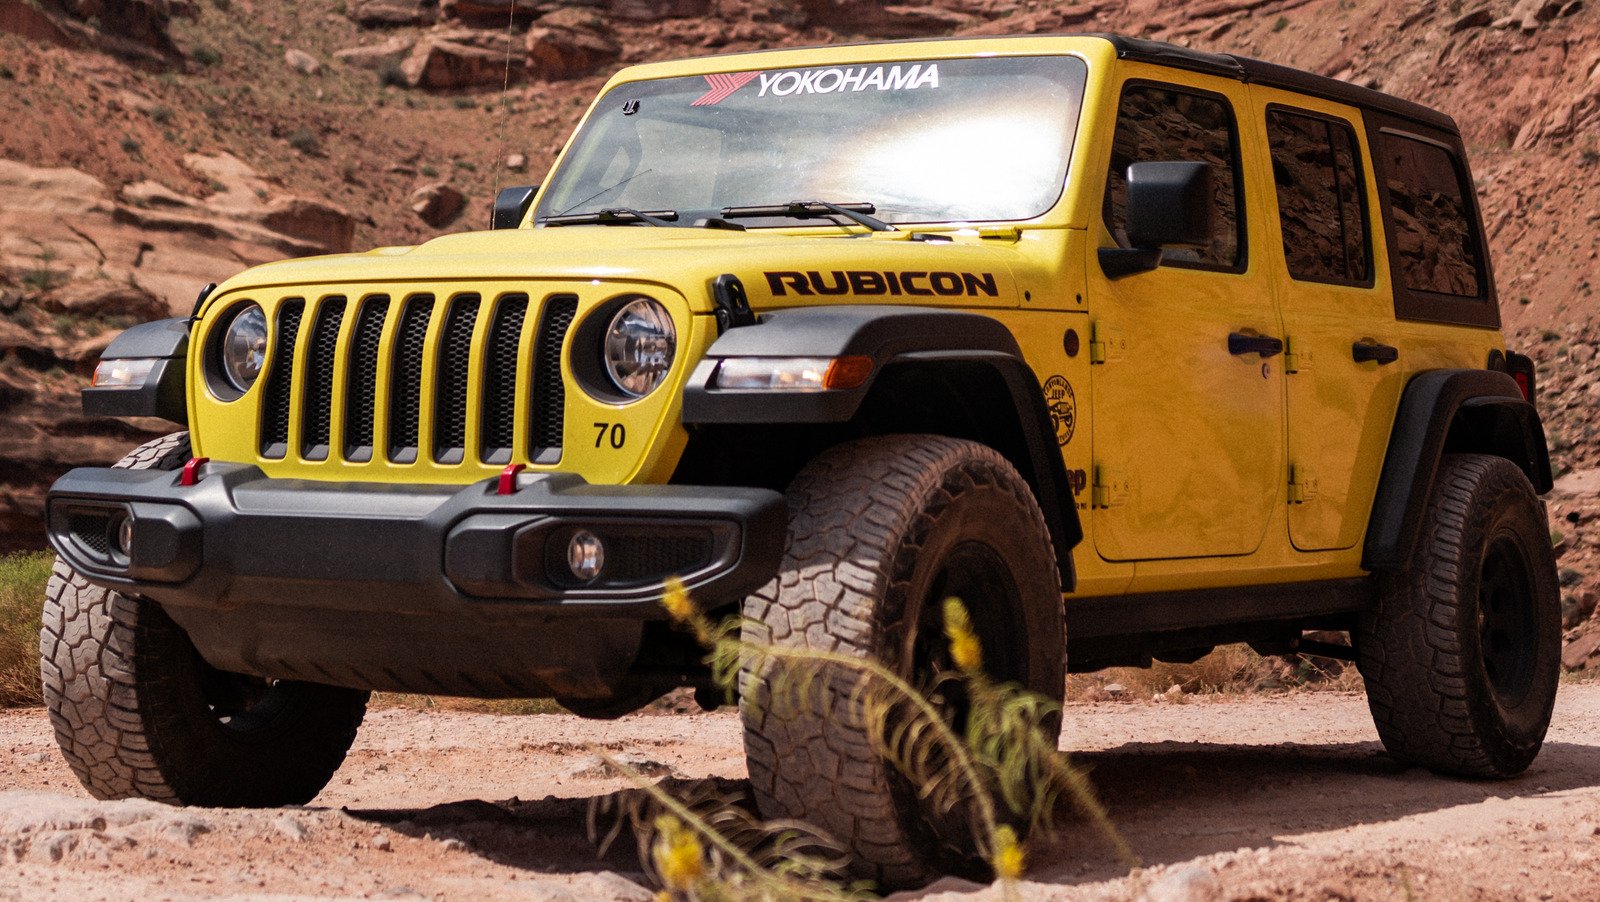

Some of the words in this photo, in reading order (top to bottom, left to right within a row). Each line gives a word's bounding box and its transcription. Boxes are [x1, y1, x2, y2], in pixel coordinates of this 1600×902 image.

[758, 64, 939, 97] YOKOHAMA
[763, 271, 999, 297] RUBICON
[1052, 389, 1066, 399] JEEP
[593, 422, 626, 449] 70
[1066, 469, 1087, 496] ep
